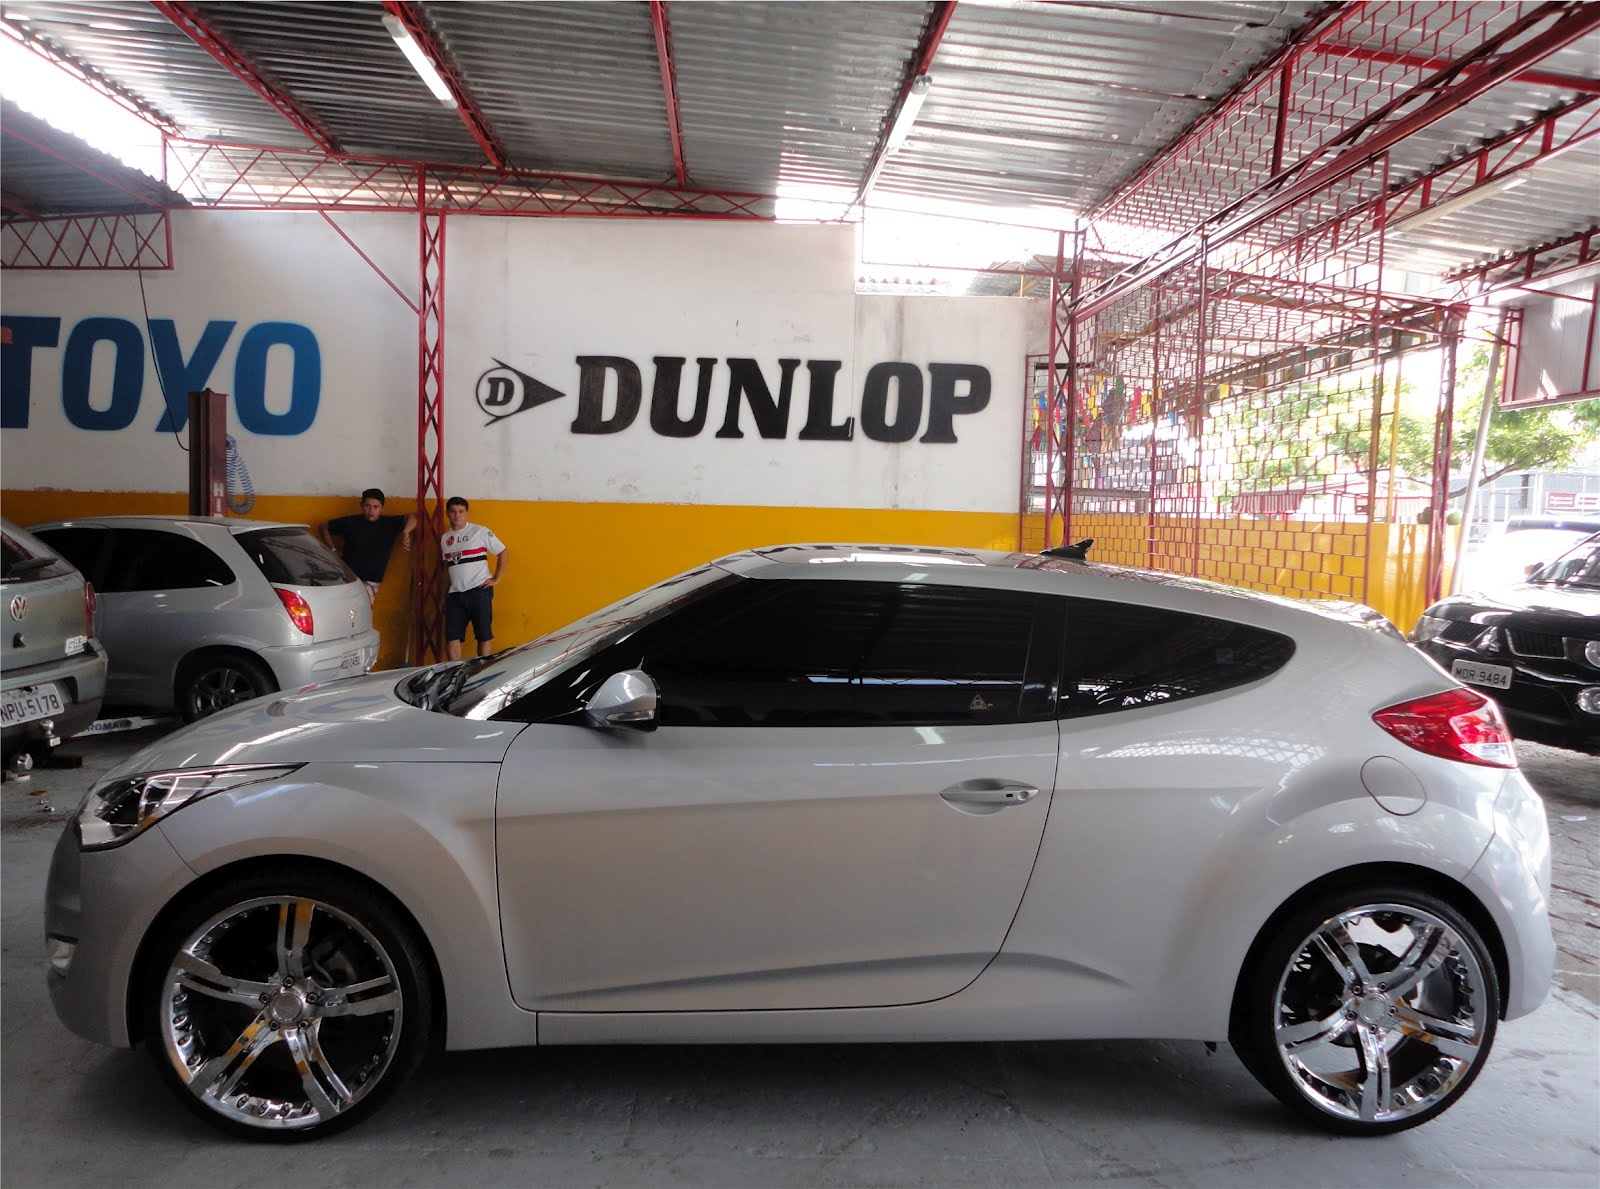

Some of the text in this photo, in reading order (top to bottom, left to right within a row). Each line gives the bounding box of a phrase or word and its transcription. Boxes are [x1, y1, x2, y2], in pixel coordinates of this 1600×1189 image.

[0, 315, 321, 436] TOYO
[570, 355, 992, 444] DUNLOP
[456, 535, 469, 543] LG
